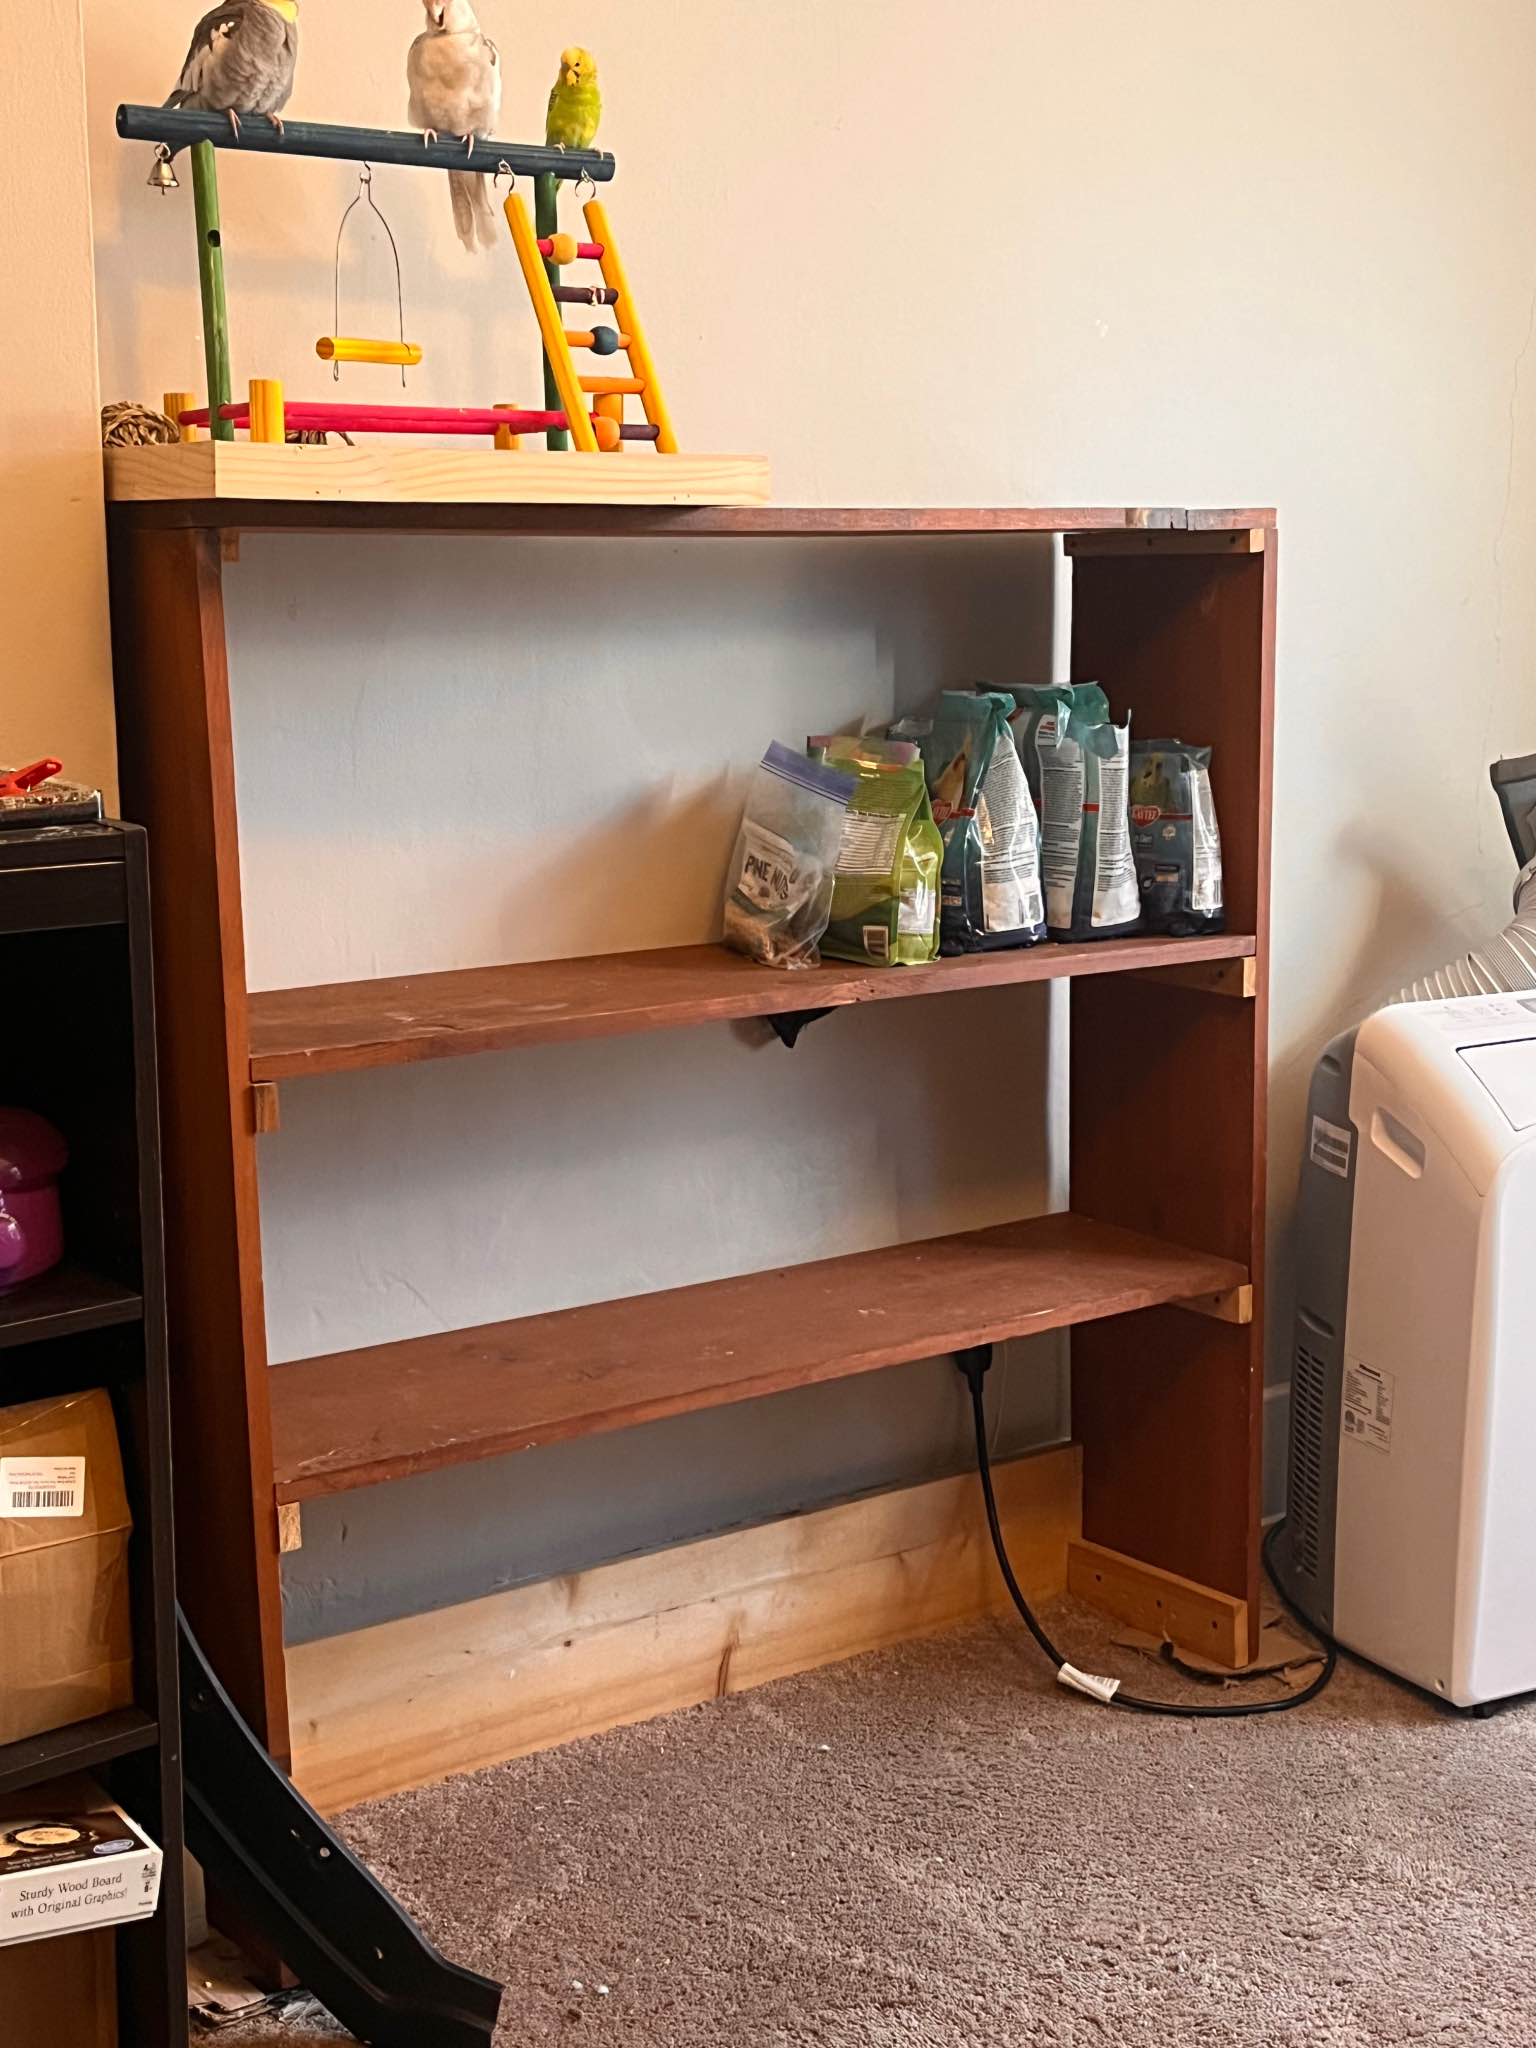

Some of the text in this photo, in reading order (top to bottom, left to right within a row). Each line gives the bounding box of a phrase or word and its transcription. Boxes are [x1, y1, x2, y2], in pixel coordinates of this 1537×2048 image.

[744, 855, 771, 882] PINE
[19, 1873, 123, 1902] Sturdy Wood Board
[11, 1906, 34, 1919] with
[38, 1896, 81, 1914] Original
